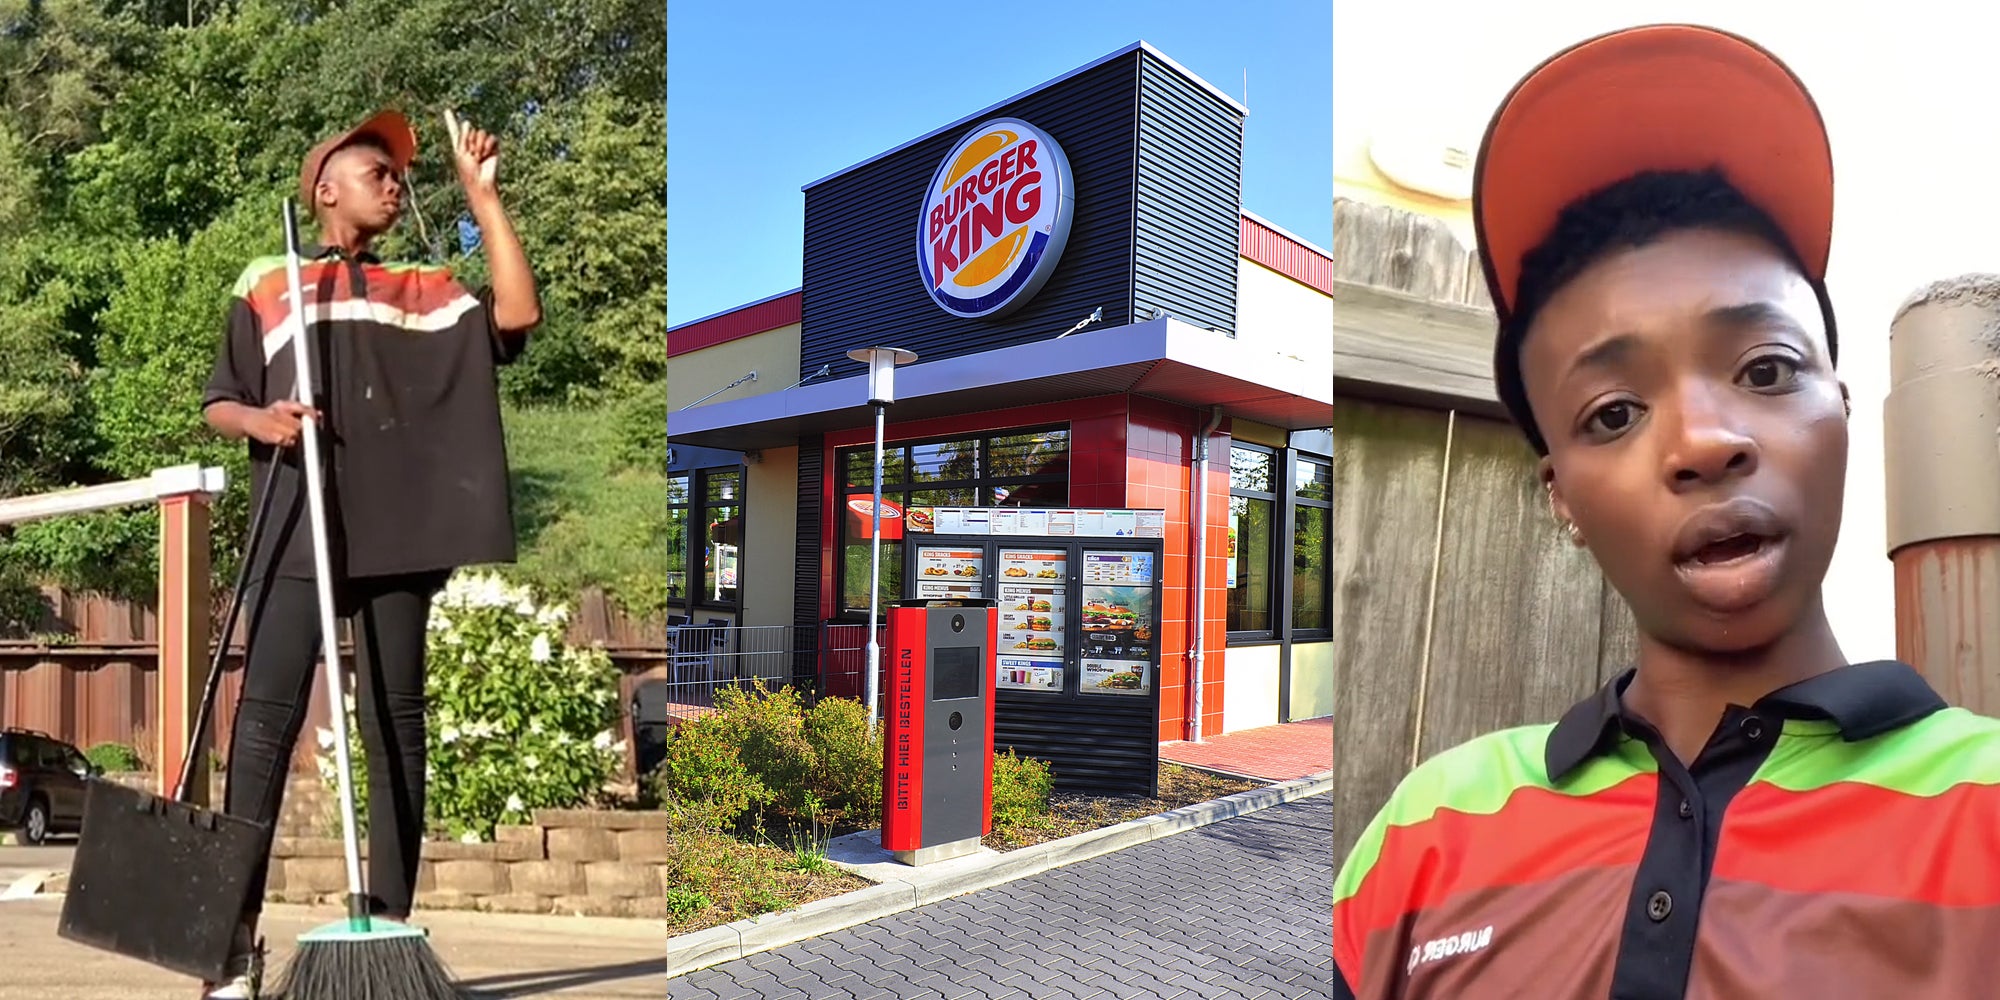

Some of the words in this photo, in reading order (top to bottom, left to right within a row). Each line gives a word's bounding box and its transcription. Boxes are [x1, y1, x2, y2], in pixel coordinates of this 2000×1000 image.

[930, 139, 1037, 245] BURGER
[934, 170, 1042, 289] KING
[900, 648, 912, 728] BESTELLEN
[899, 734, 910, 766] HIER
[898, 772, 909, 810] BITTE
